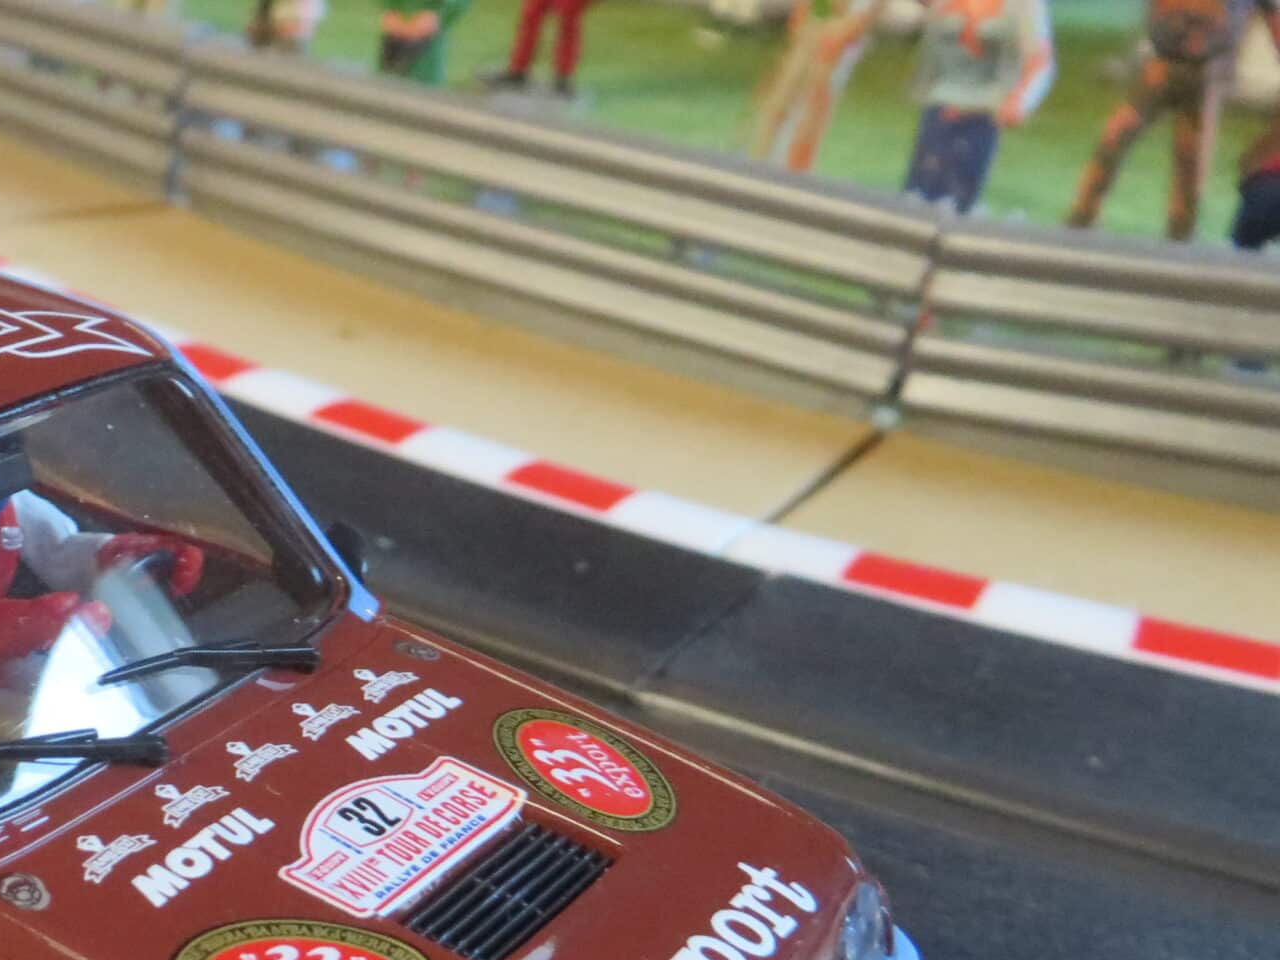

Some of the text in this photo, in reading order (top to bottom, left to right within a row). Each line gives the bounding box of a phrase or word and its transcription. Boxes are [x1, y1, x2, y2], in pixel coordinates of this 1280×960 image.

[345, 687, 465, 761] MOTUL
[565, 732, 646, 799] export
[337, 796, 402, 837] 32
[414, 814, 451, 840] DE
[431, 780, 498, 827] CORSE
[130, 807, 277, 909] MOTUL
[375, 864, 421, 899] RALLYE
[421, 848, 440, 865] DE
[440, 813, 487, 850] FRANCE
[376, 829, 433, 867] TOUR
